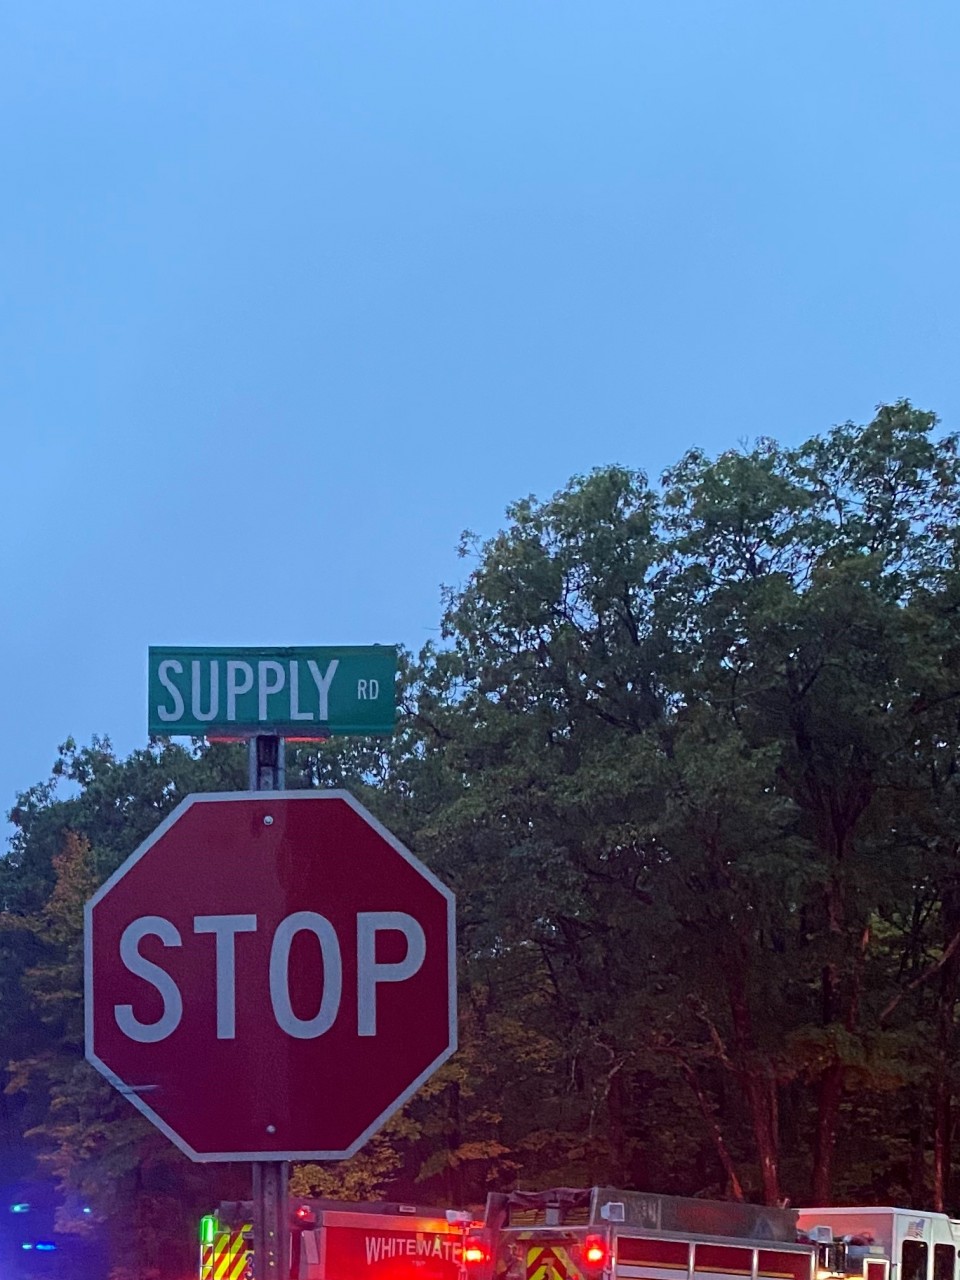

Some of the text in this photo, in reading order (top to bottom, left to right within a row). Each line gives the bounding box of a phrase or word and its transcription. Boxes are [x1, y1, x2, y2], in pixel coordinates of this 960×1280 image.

[157, 659, 379, 721] SUPPLY RD
[114, 910, 427, 1043] STOP
[365, 1235, 462, 1266] WHITEWATE
